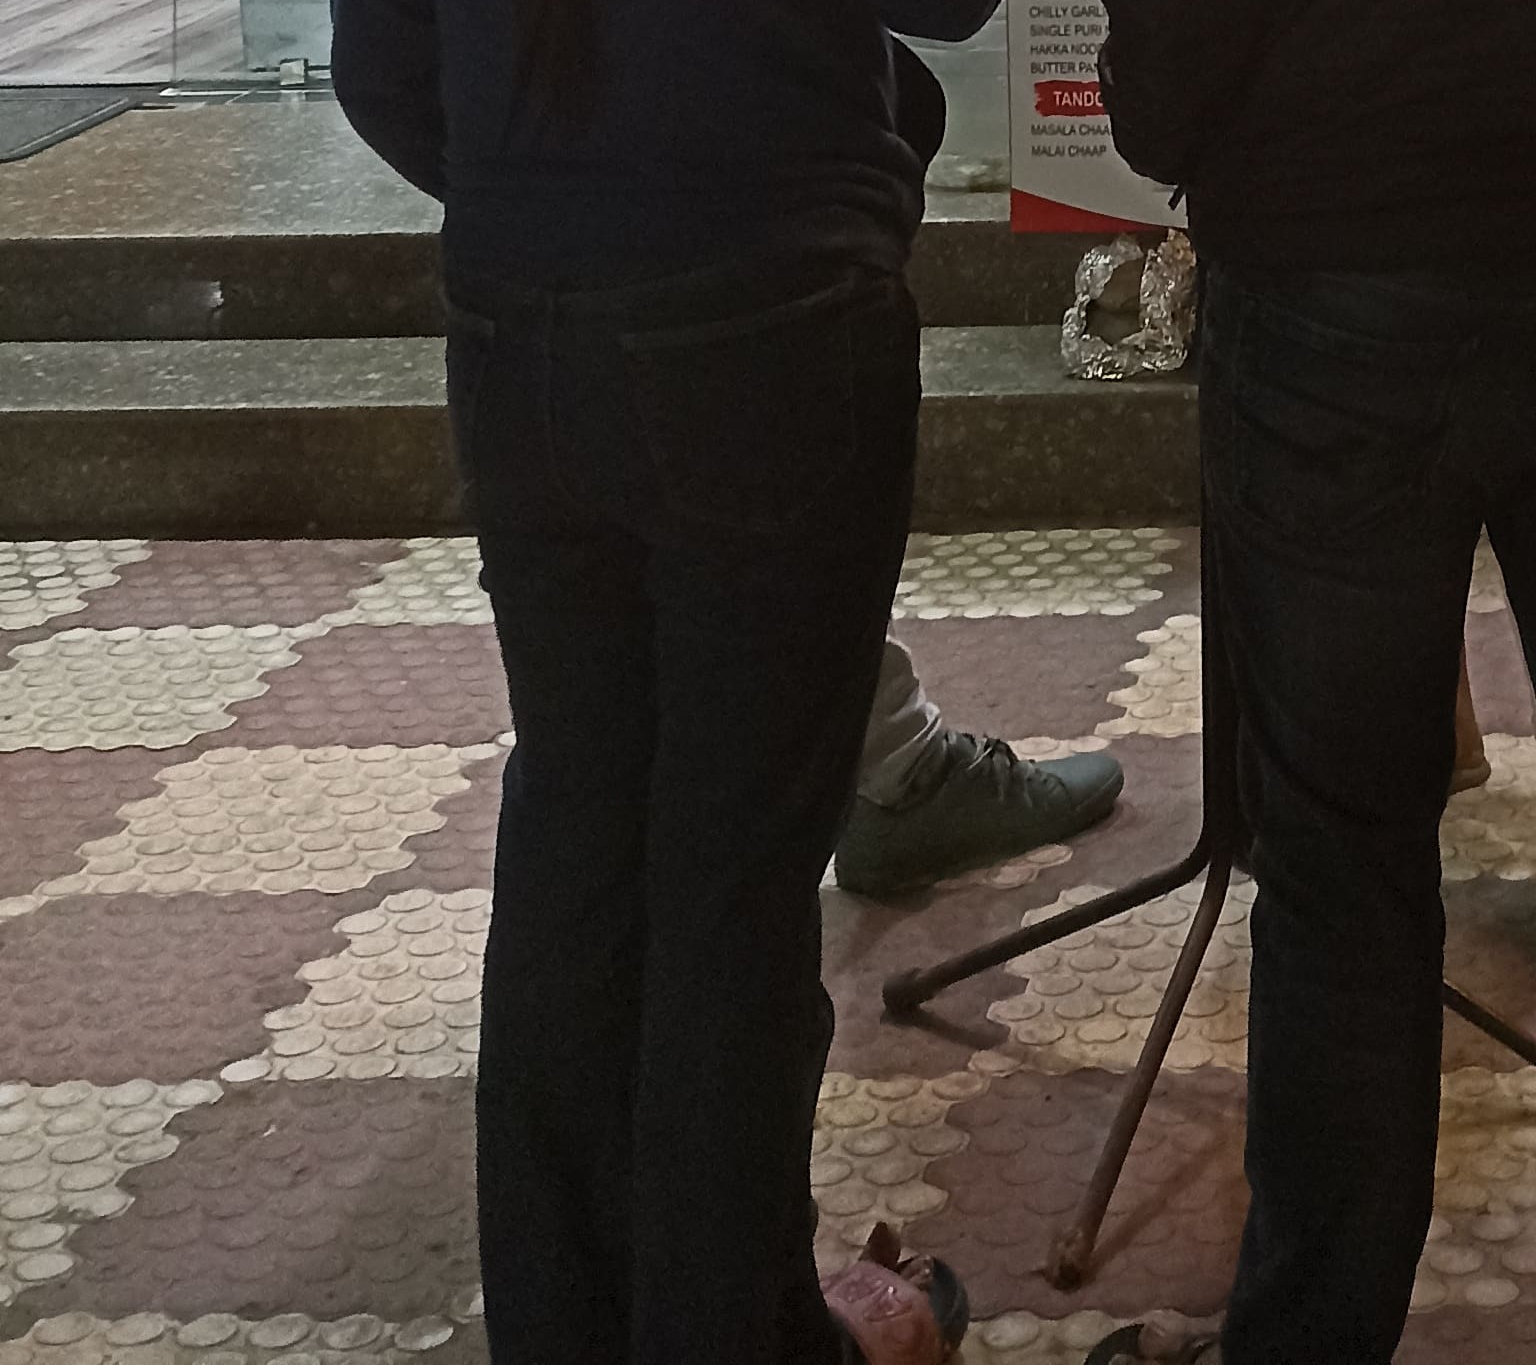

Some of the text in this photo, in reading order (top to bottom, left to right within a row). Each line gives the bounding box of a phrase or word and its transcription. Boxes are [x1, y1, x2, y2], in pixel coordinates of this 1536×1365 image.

[1029, 6, 1067, 18] CHILLY
[1030, 24, 1070, 37] SINGLE
[1030, 43, 1069, 55] HAKKA
[1031, 62, 1076, 74] BUTTER
[1031, 124, 1076, 136] MASALA
[1031, 144, 1106, 157] MALAI CHAAP
